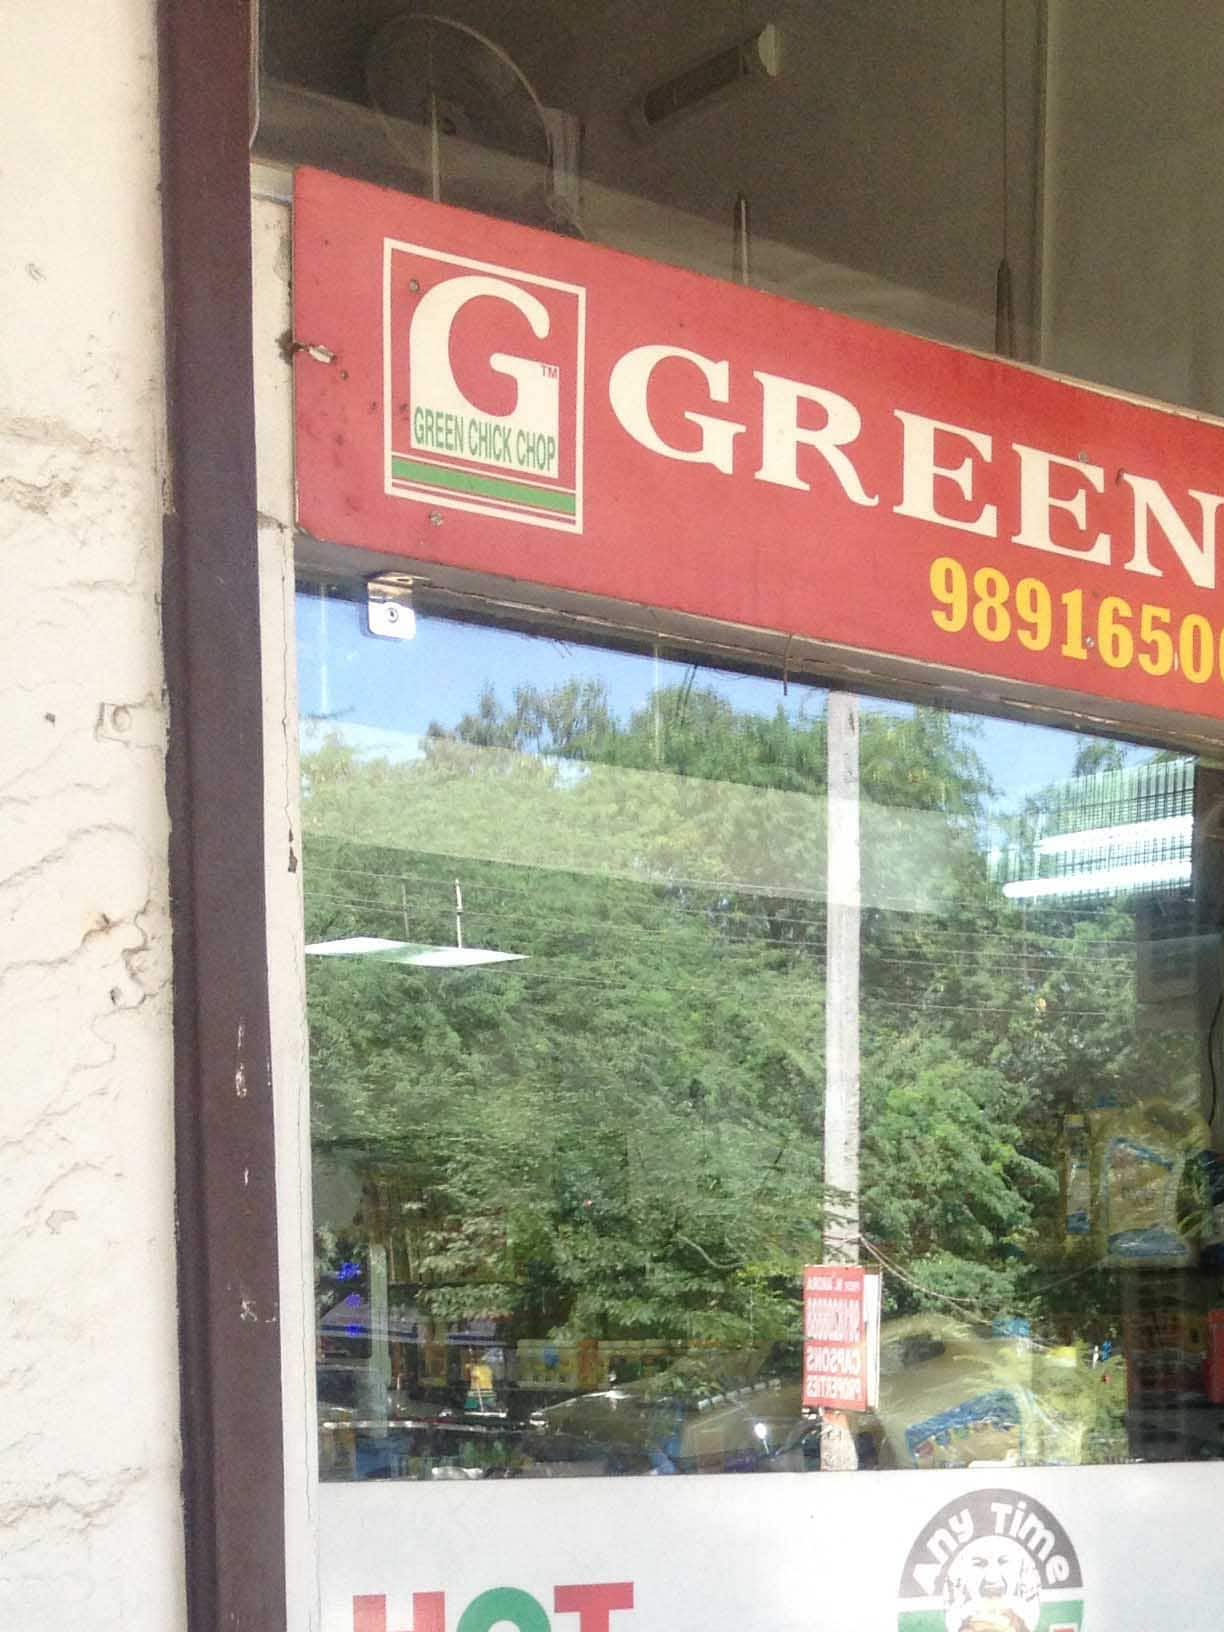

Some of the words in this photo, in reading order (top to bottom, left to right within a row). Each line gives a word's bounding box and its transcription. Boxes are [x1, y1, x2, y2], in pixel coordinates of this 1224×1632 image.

[409, 275, 559, 479] G
[413, 405, 464, 454] GREEN
[468, 418, 512, 464] CHICK
[516, 429, 557, 472] CHOP
